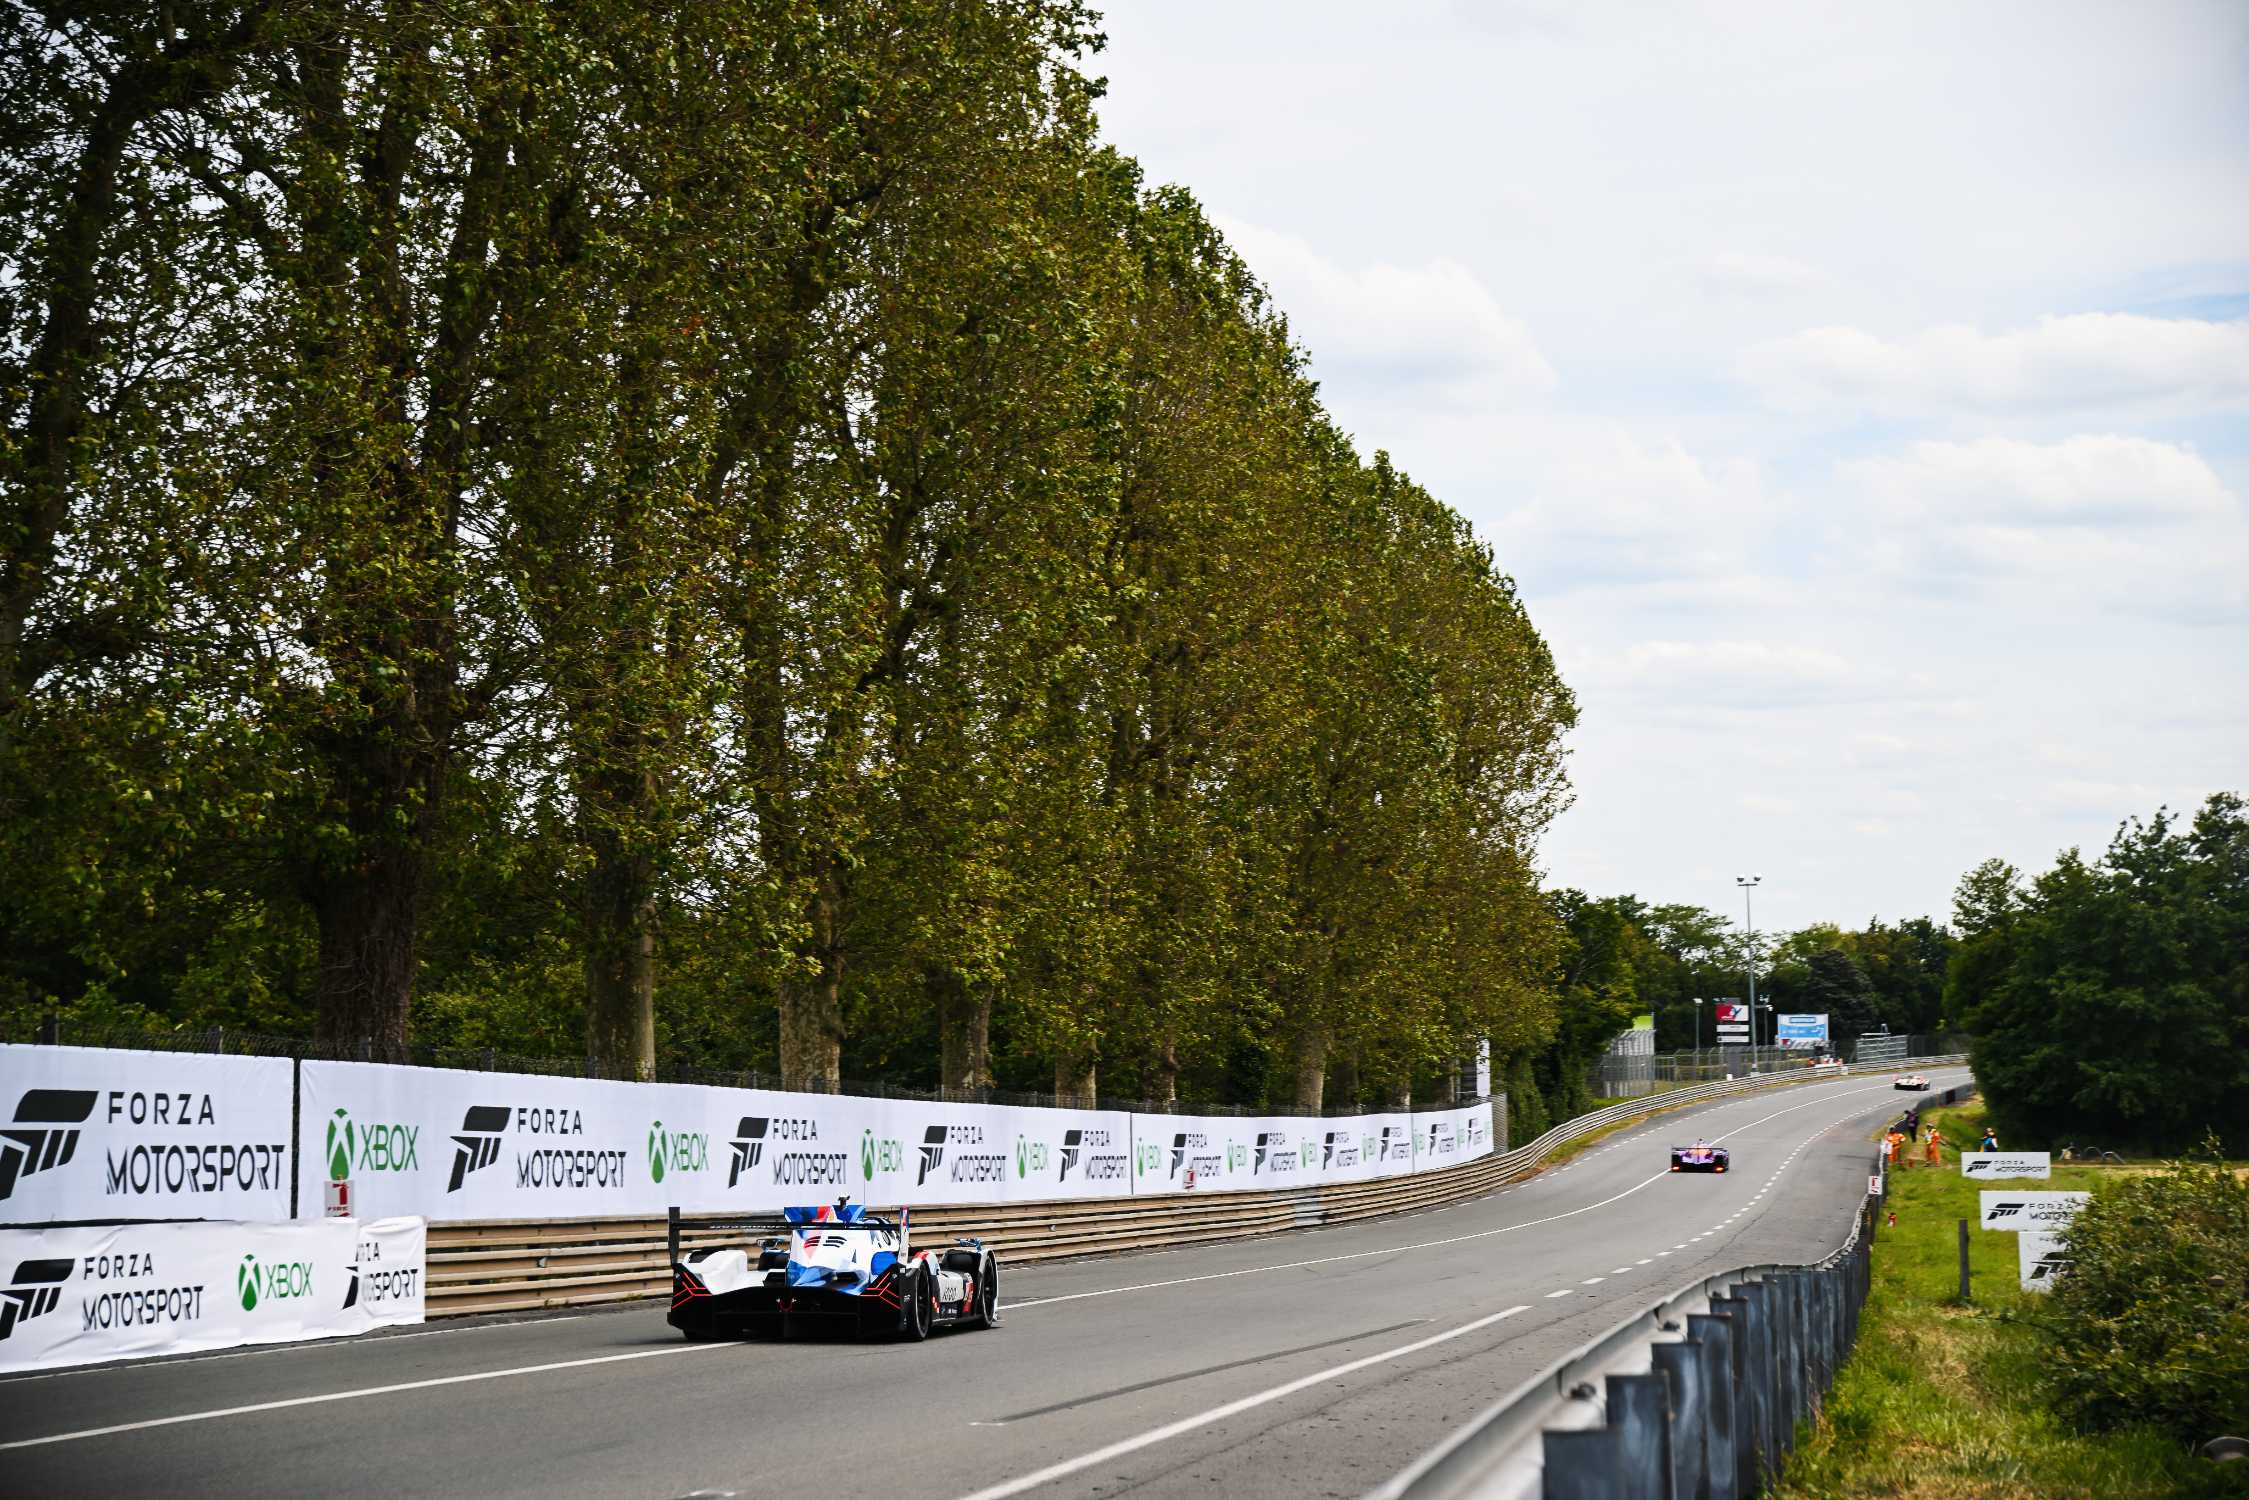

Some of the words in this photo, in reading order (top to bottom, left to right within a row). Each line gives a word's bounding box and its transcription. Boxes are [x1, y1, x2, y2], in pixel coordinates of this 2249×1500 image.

[107, 1091, 215, 1125] FORZA
[517, 1107, 583, 1135] FORZA
[772, 1118, 819, 1140] FORZA
[950, 1126, 984, 1144] FORZA
[358, 1123, 420, 1172] XBOX
[669, 1132, 710, 1172] XBOX
[106, 1144, 286, 1195] MOTORSPORT
[516, 1150, 628, 1188] MOTORSPORT
[772, 1153, 848, 1185] MOTORSPORT
[83, 1253, 154, 1280] FORZA
[264, 1261, 313, 1300] XBOX
[82, 1286, 205, 1331] MOTORSPORT
